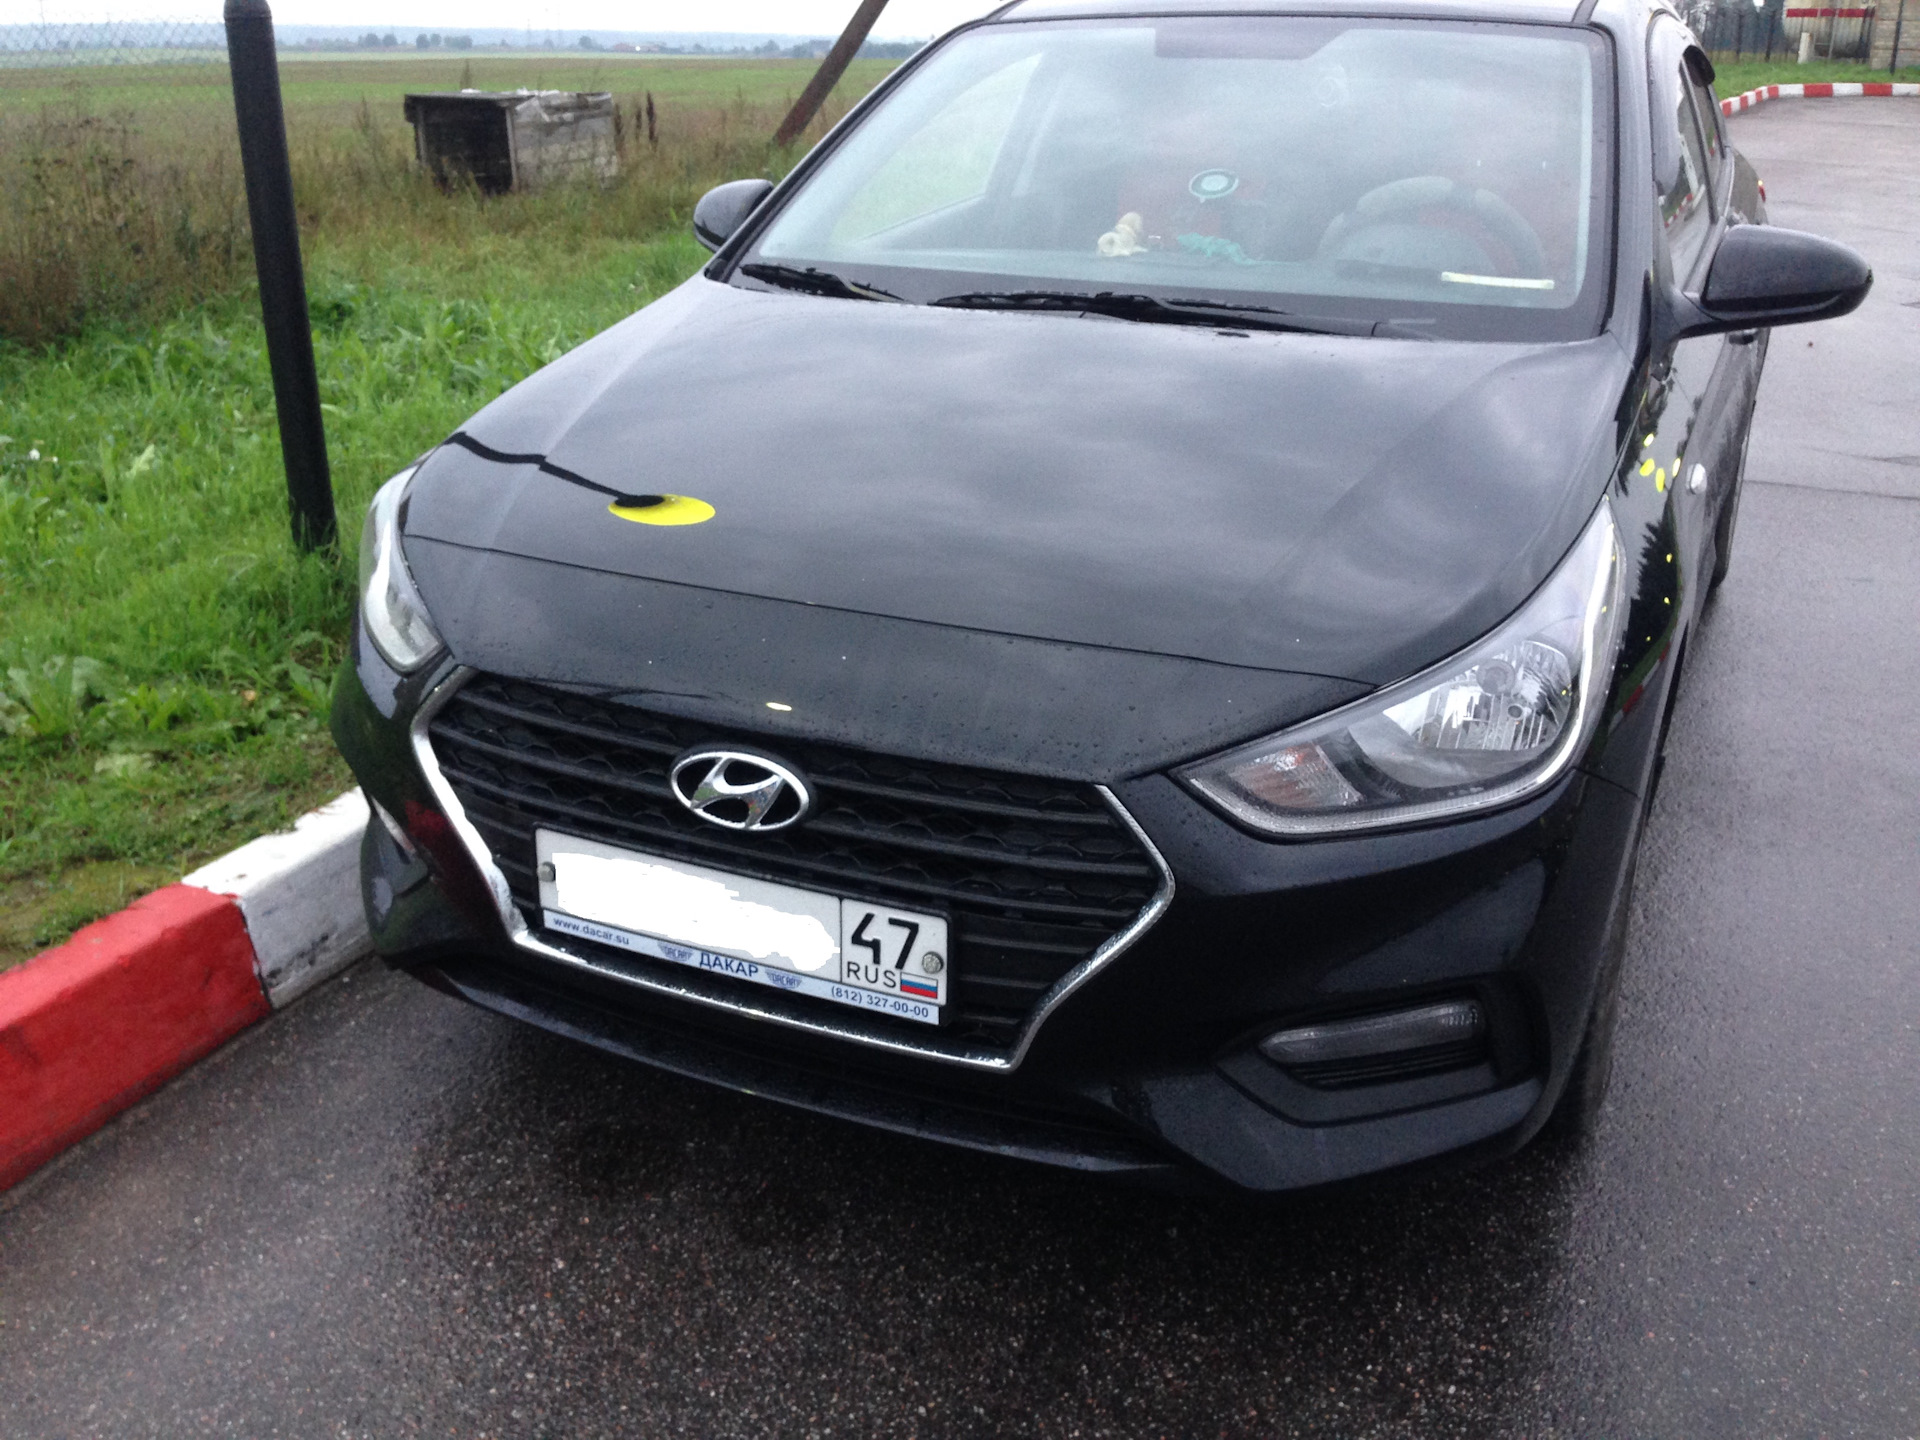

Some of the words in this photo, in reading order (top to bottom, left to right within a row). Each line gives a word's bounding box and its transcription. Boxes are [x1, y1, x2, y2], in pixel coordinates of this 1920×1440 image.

[553, 917, 630, 946] www.dacar.su
[851, 913, 919, 969] 47
[699, 952, 759, 977] ДАКАР
[846, 961, 897, 988] RUS
[830, 986, 863, 1003] (812)
[866, 995, 929, 1018] 327-00-00
